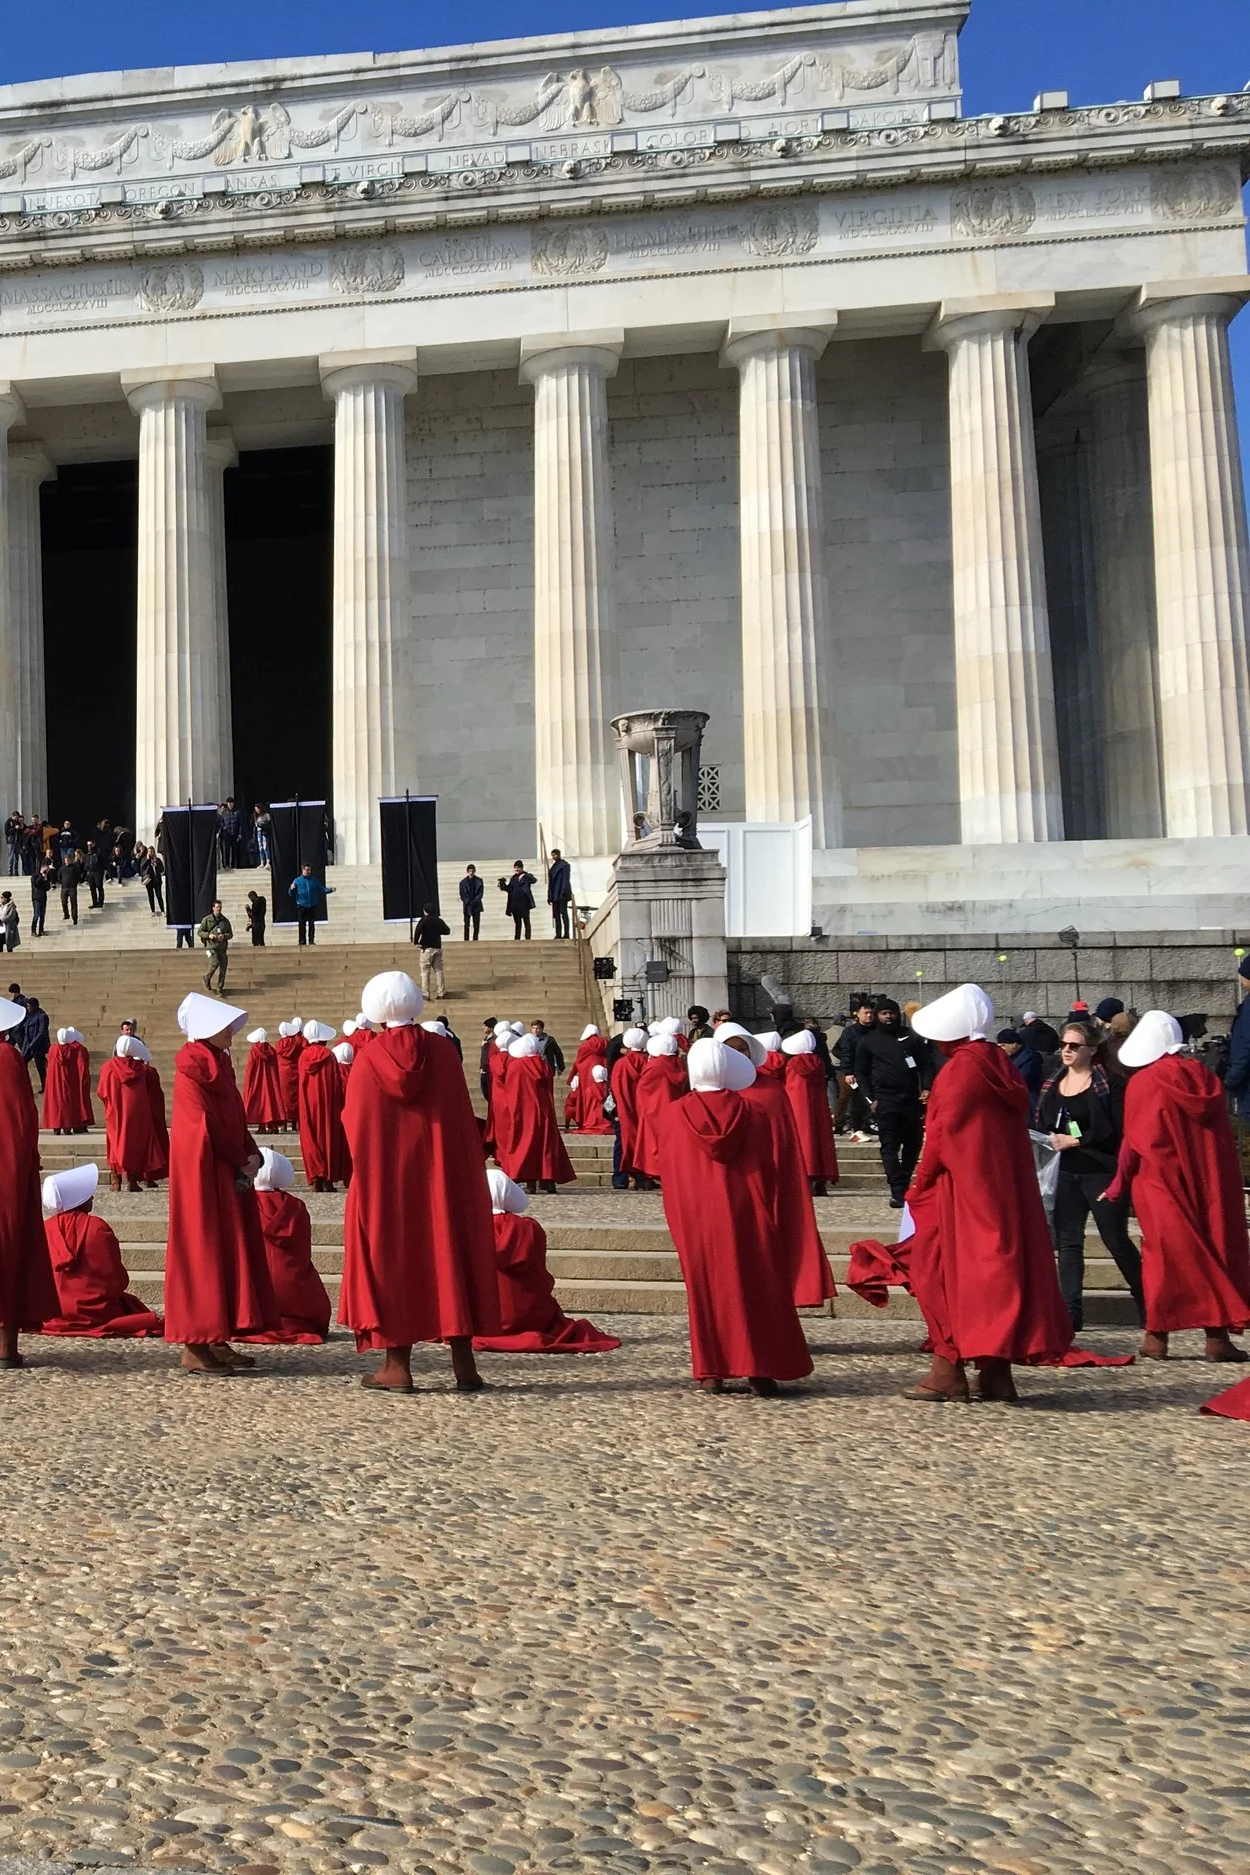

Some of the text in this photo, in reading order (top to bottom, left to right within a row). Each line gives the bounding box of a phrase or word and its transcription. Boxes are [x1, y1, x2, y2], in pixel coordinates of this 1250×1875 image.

[227, 174, 278, 190] ANSAS
[448, 150, 505, 169] NEVAD
[849, 109, 920, 128] DAKOTA
[1036, 184, 1148, 210] NEW YORK
[832, 203, 939, 228] VIRGINIA
[613, 223, 739, 248] HAMPSHIRE
[418, 243, 520, 268] CAROLINA
[213, 262, 324, 288] MARYLAND
[2, 278, 131, 306] MASSACHUSETTS
